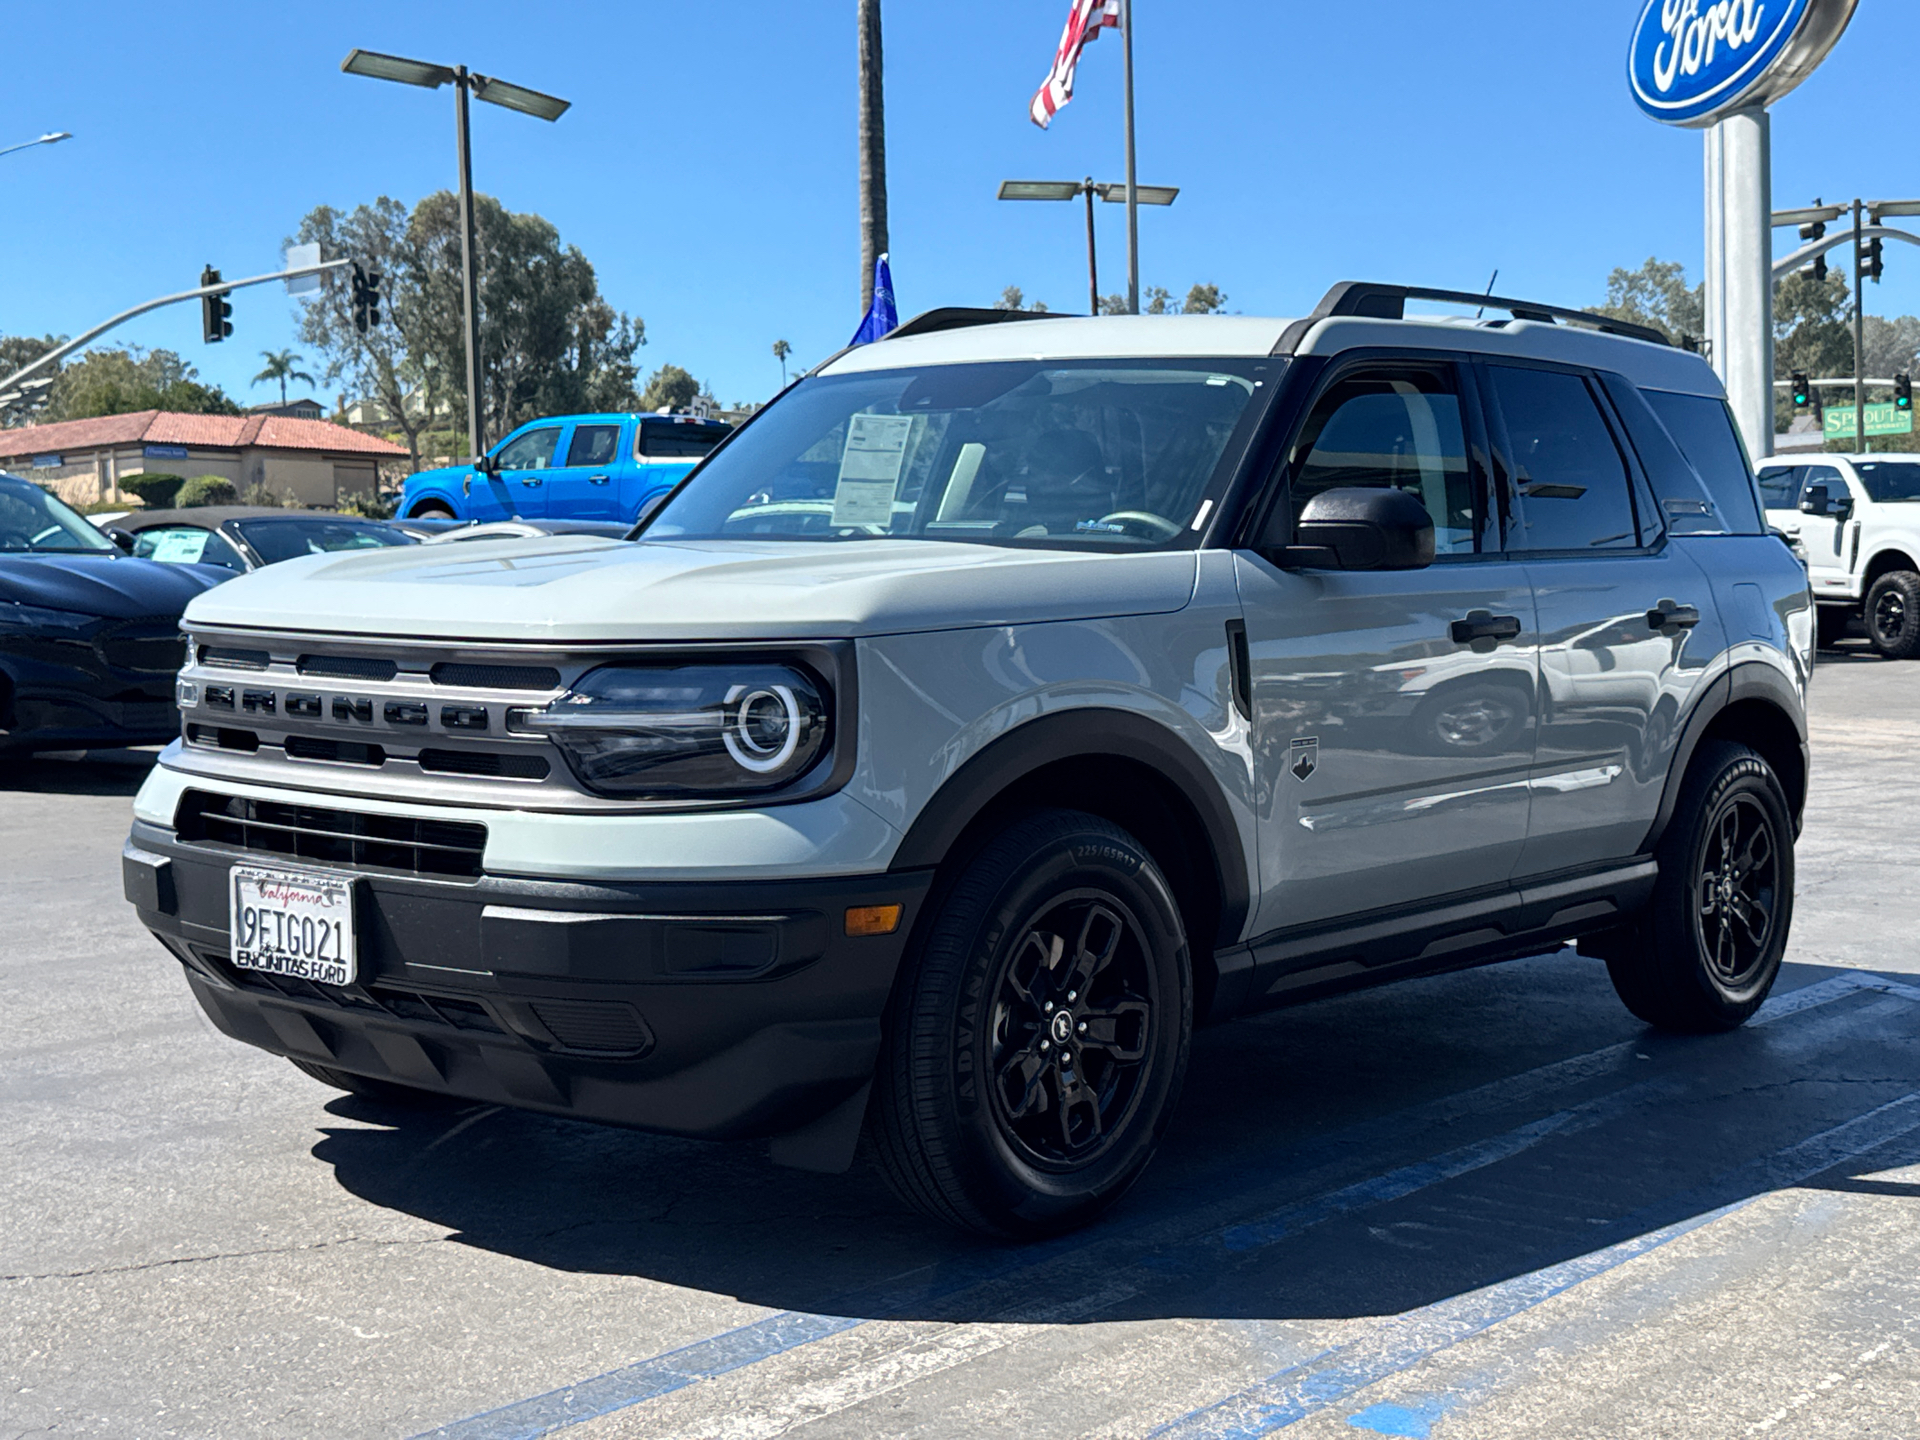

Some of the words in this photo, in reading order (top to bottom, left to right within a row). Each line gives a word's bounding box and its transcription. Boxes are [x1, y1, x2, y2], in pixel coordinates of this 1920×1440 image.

[1653, 0, 1765, 93] Ford
[205, 685, 488, 730] BRONCO
[1077, 844, 1136, 868] 225/65R17
[257, 880, 333, 909] California
[237, 950, 309, 977] ENCINITAS
[311, 962, 346, 984] FORD
